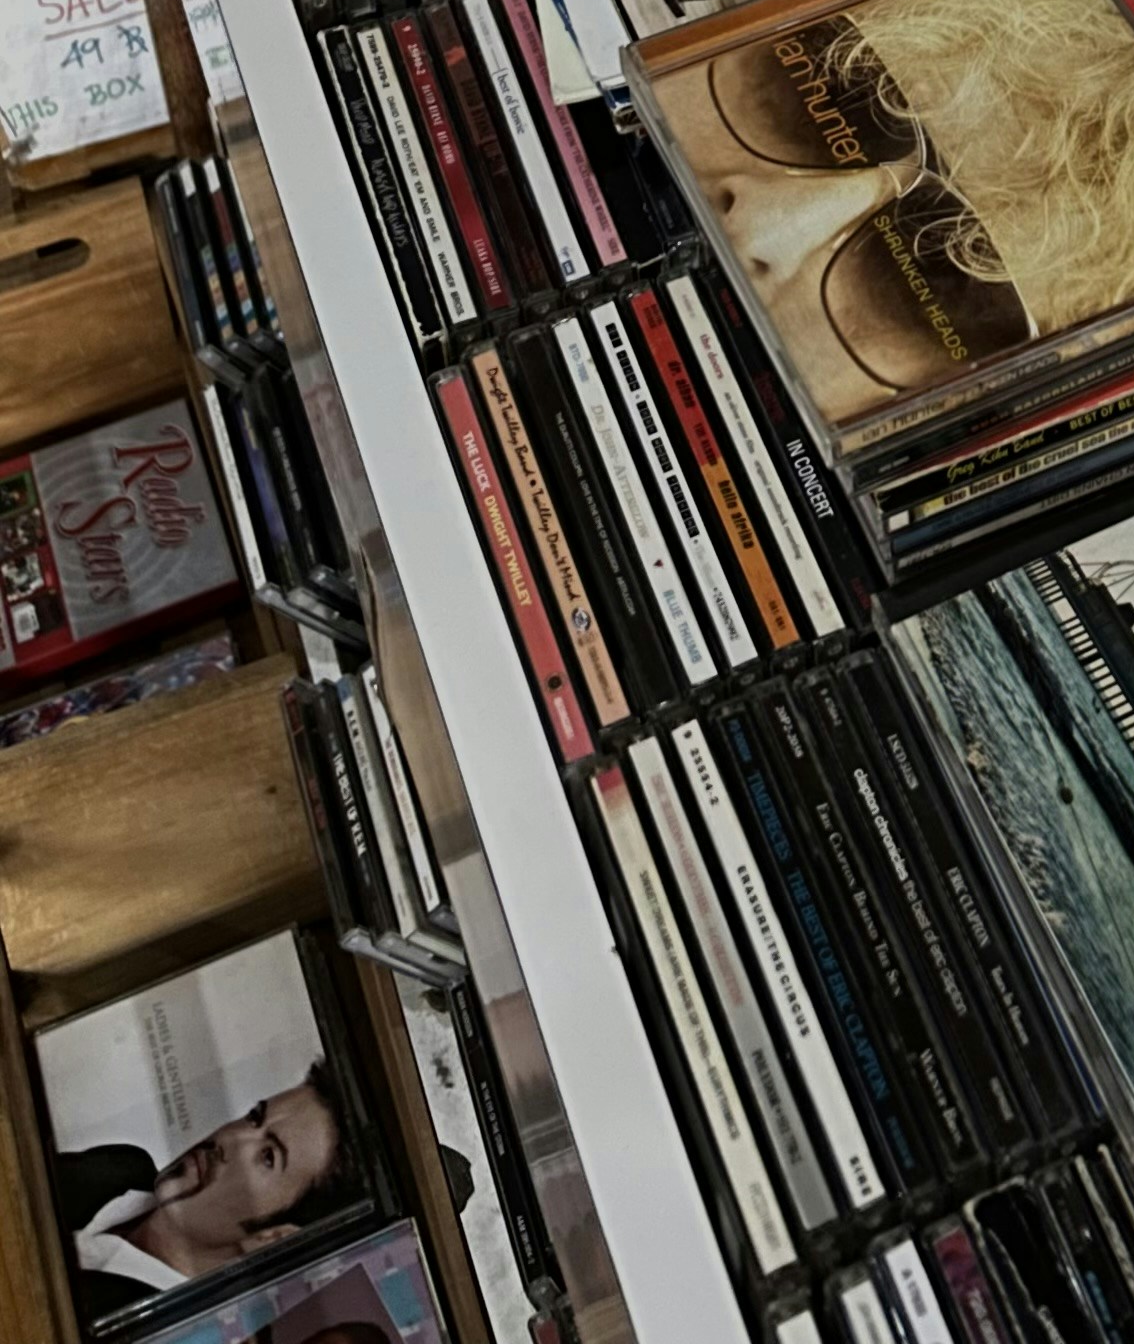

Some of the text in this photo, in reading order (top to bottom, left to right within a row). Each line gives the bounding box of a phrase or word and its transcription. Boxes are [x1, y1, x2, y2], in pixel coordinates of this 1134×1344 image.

[495, 71, 530, 135] best of bowie
[771, 28, 869, 174] ian hunter
[872, 212, 968, 362] SHRUNKEN HEADS
[111, 423, 207, 551] Radio
[459, 430, 534, 609] THE LUCK DWIGHT TWILLEY
[481, 366, 582, 602] Dwight Twilley Band Twilley Don't Mind
[784, 437, 835, 523] IN CONCERT
[940, 487, 967, 506] the
[966, 473, 1002, 495] best
[999, 466, 1018, 484] of
[1014, 457, 1042, 475] the
[1040, 442, 1080, 465] cruel
[1078, 433, 1106, 450] sea
[1105, 422, 1129, 439] the
[53, 496, 137, 605] Stars
[745, 769, 891, 1102] TIMEPIECES THE BEST OF ERIC CLAPTON
[851, 766, 971, 1019] clapton chronicles the best of eric clapton
